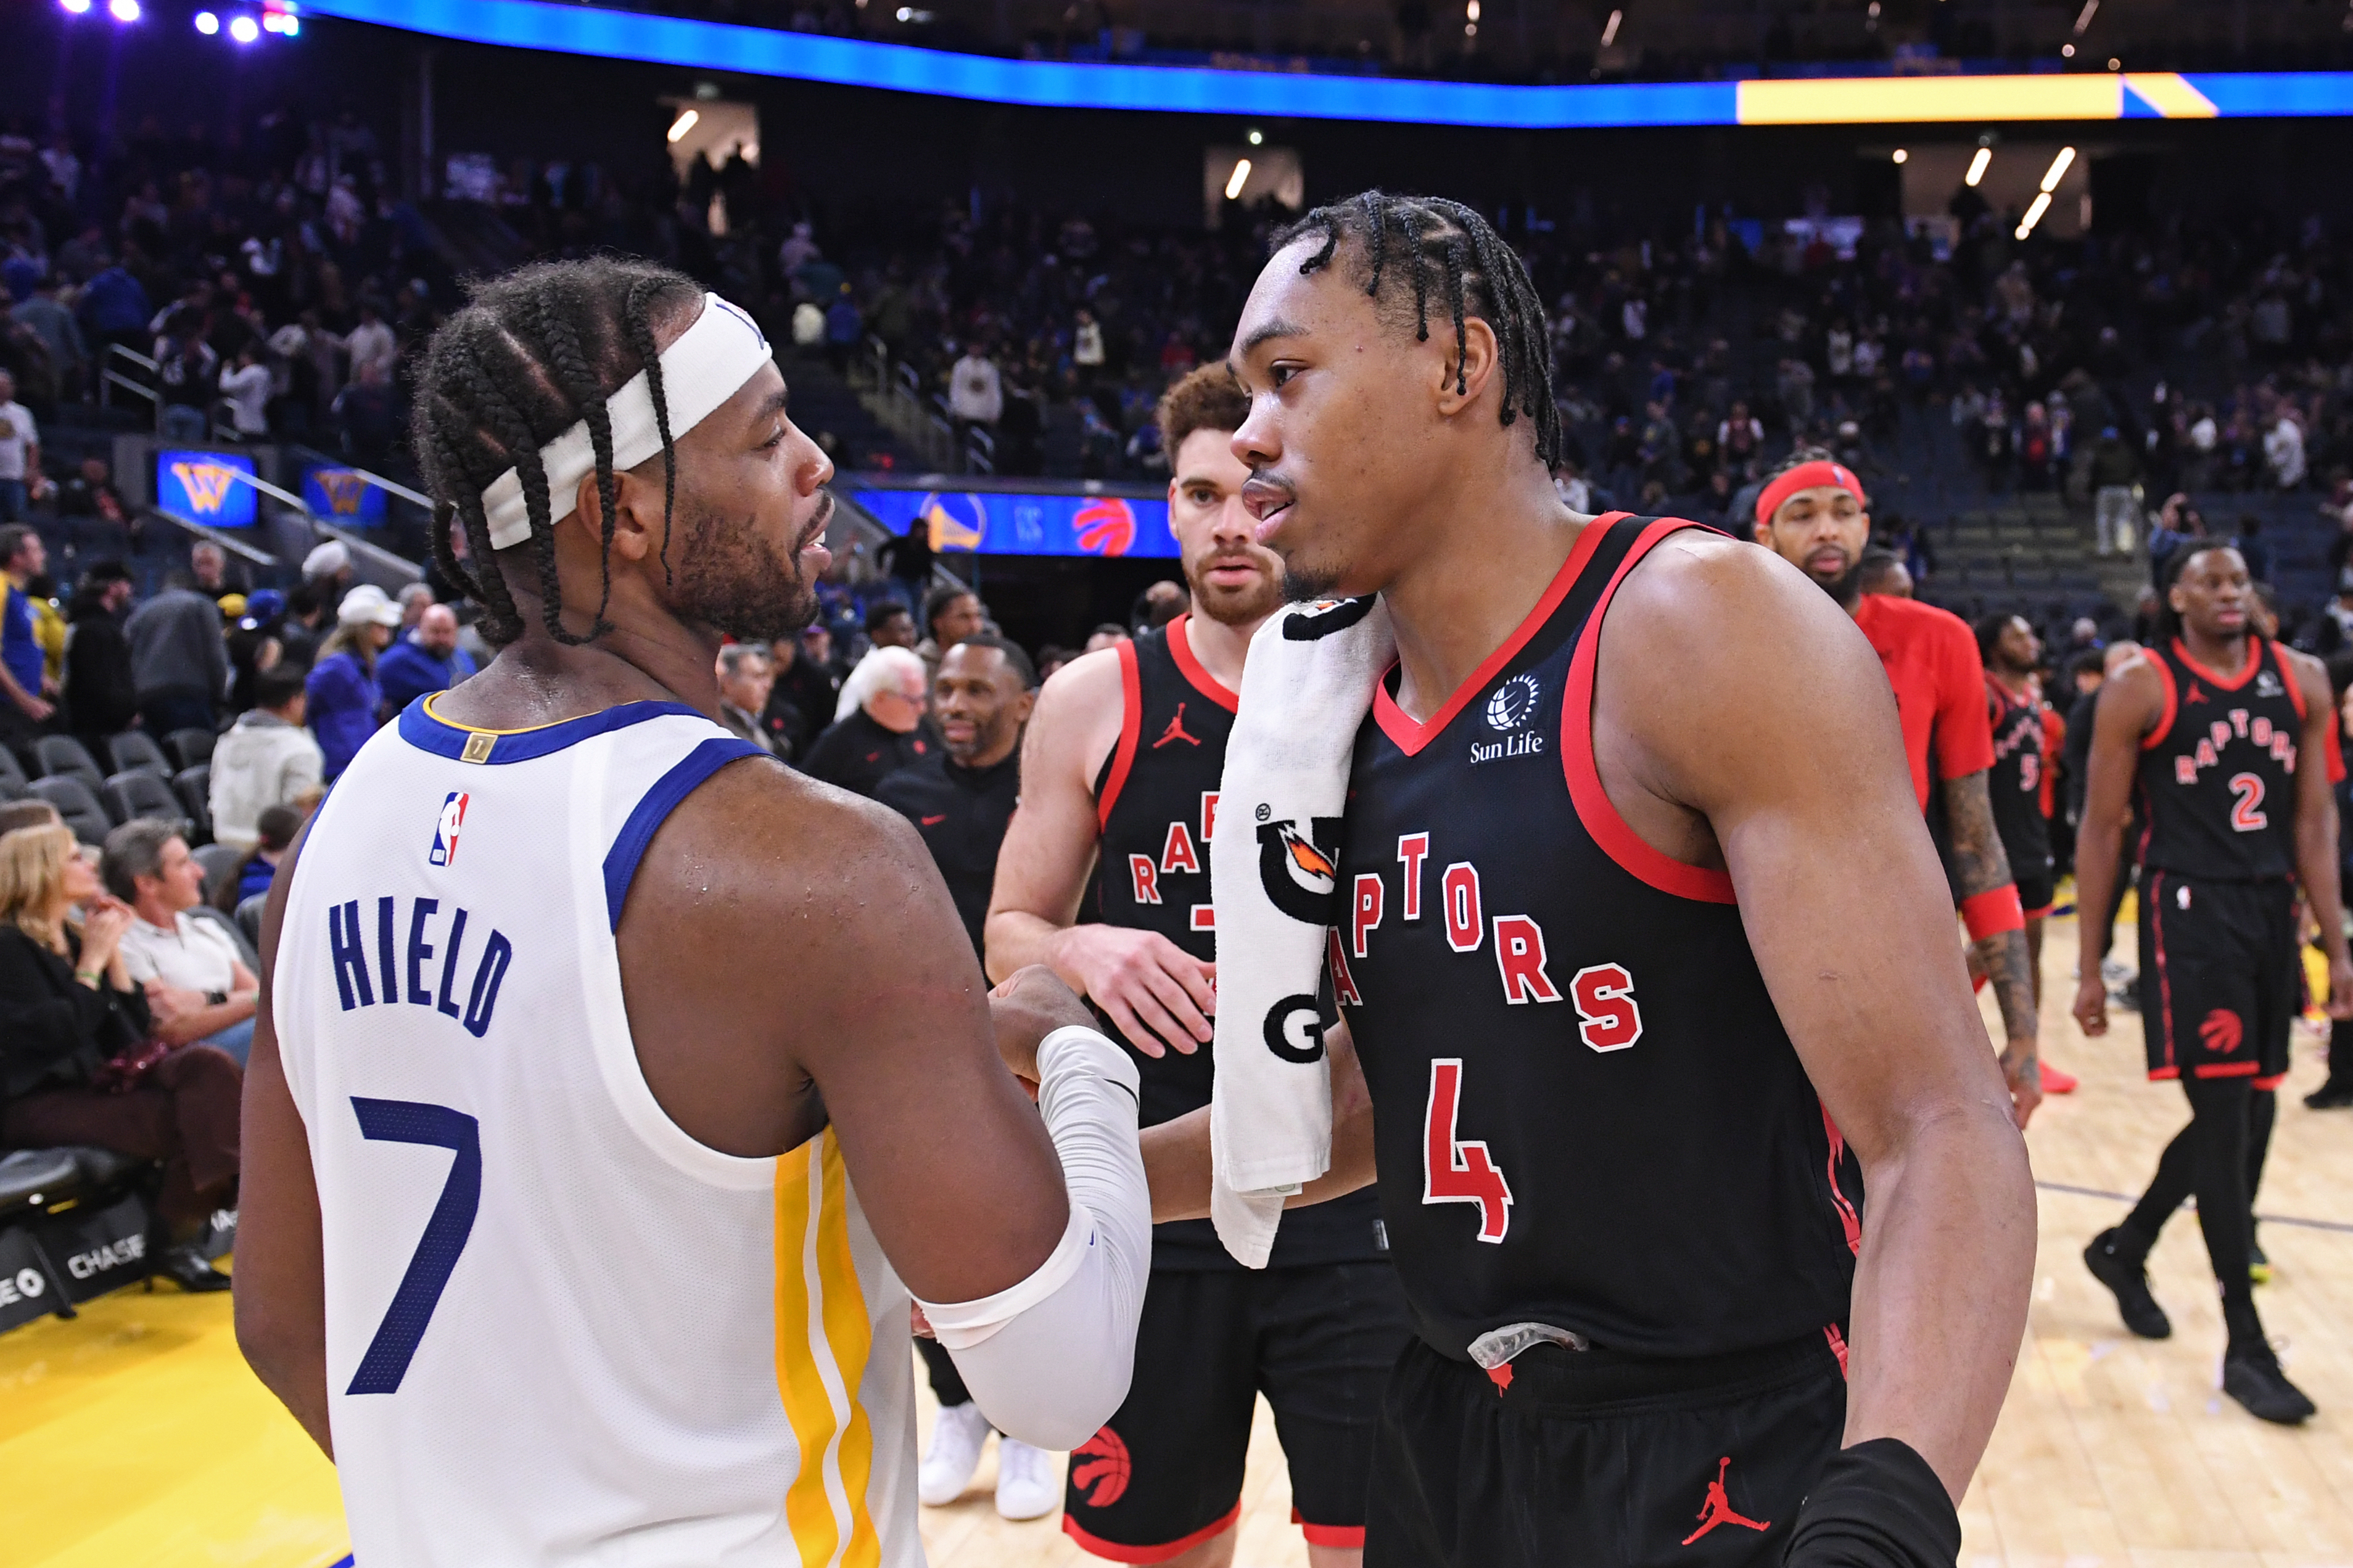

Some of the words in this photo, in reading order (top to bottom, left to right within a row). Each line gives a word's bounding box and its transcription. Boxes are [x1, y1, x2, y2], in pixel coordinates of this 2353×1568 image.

[1470, 742, 1502, 763] Sun
[1506, 730, 1543, 756] Life
[2228, 772, 2267, 832] 2
[329, 896, 512, 1038] HIELD
[1422, 1057, 1514, 1244] 4
[345, 1096, 482, 1395] 7
